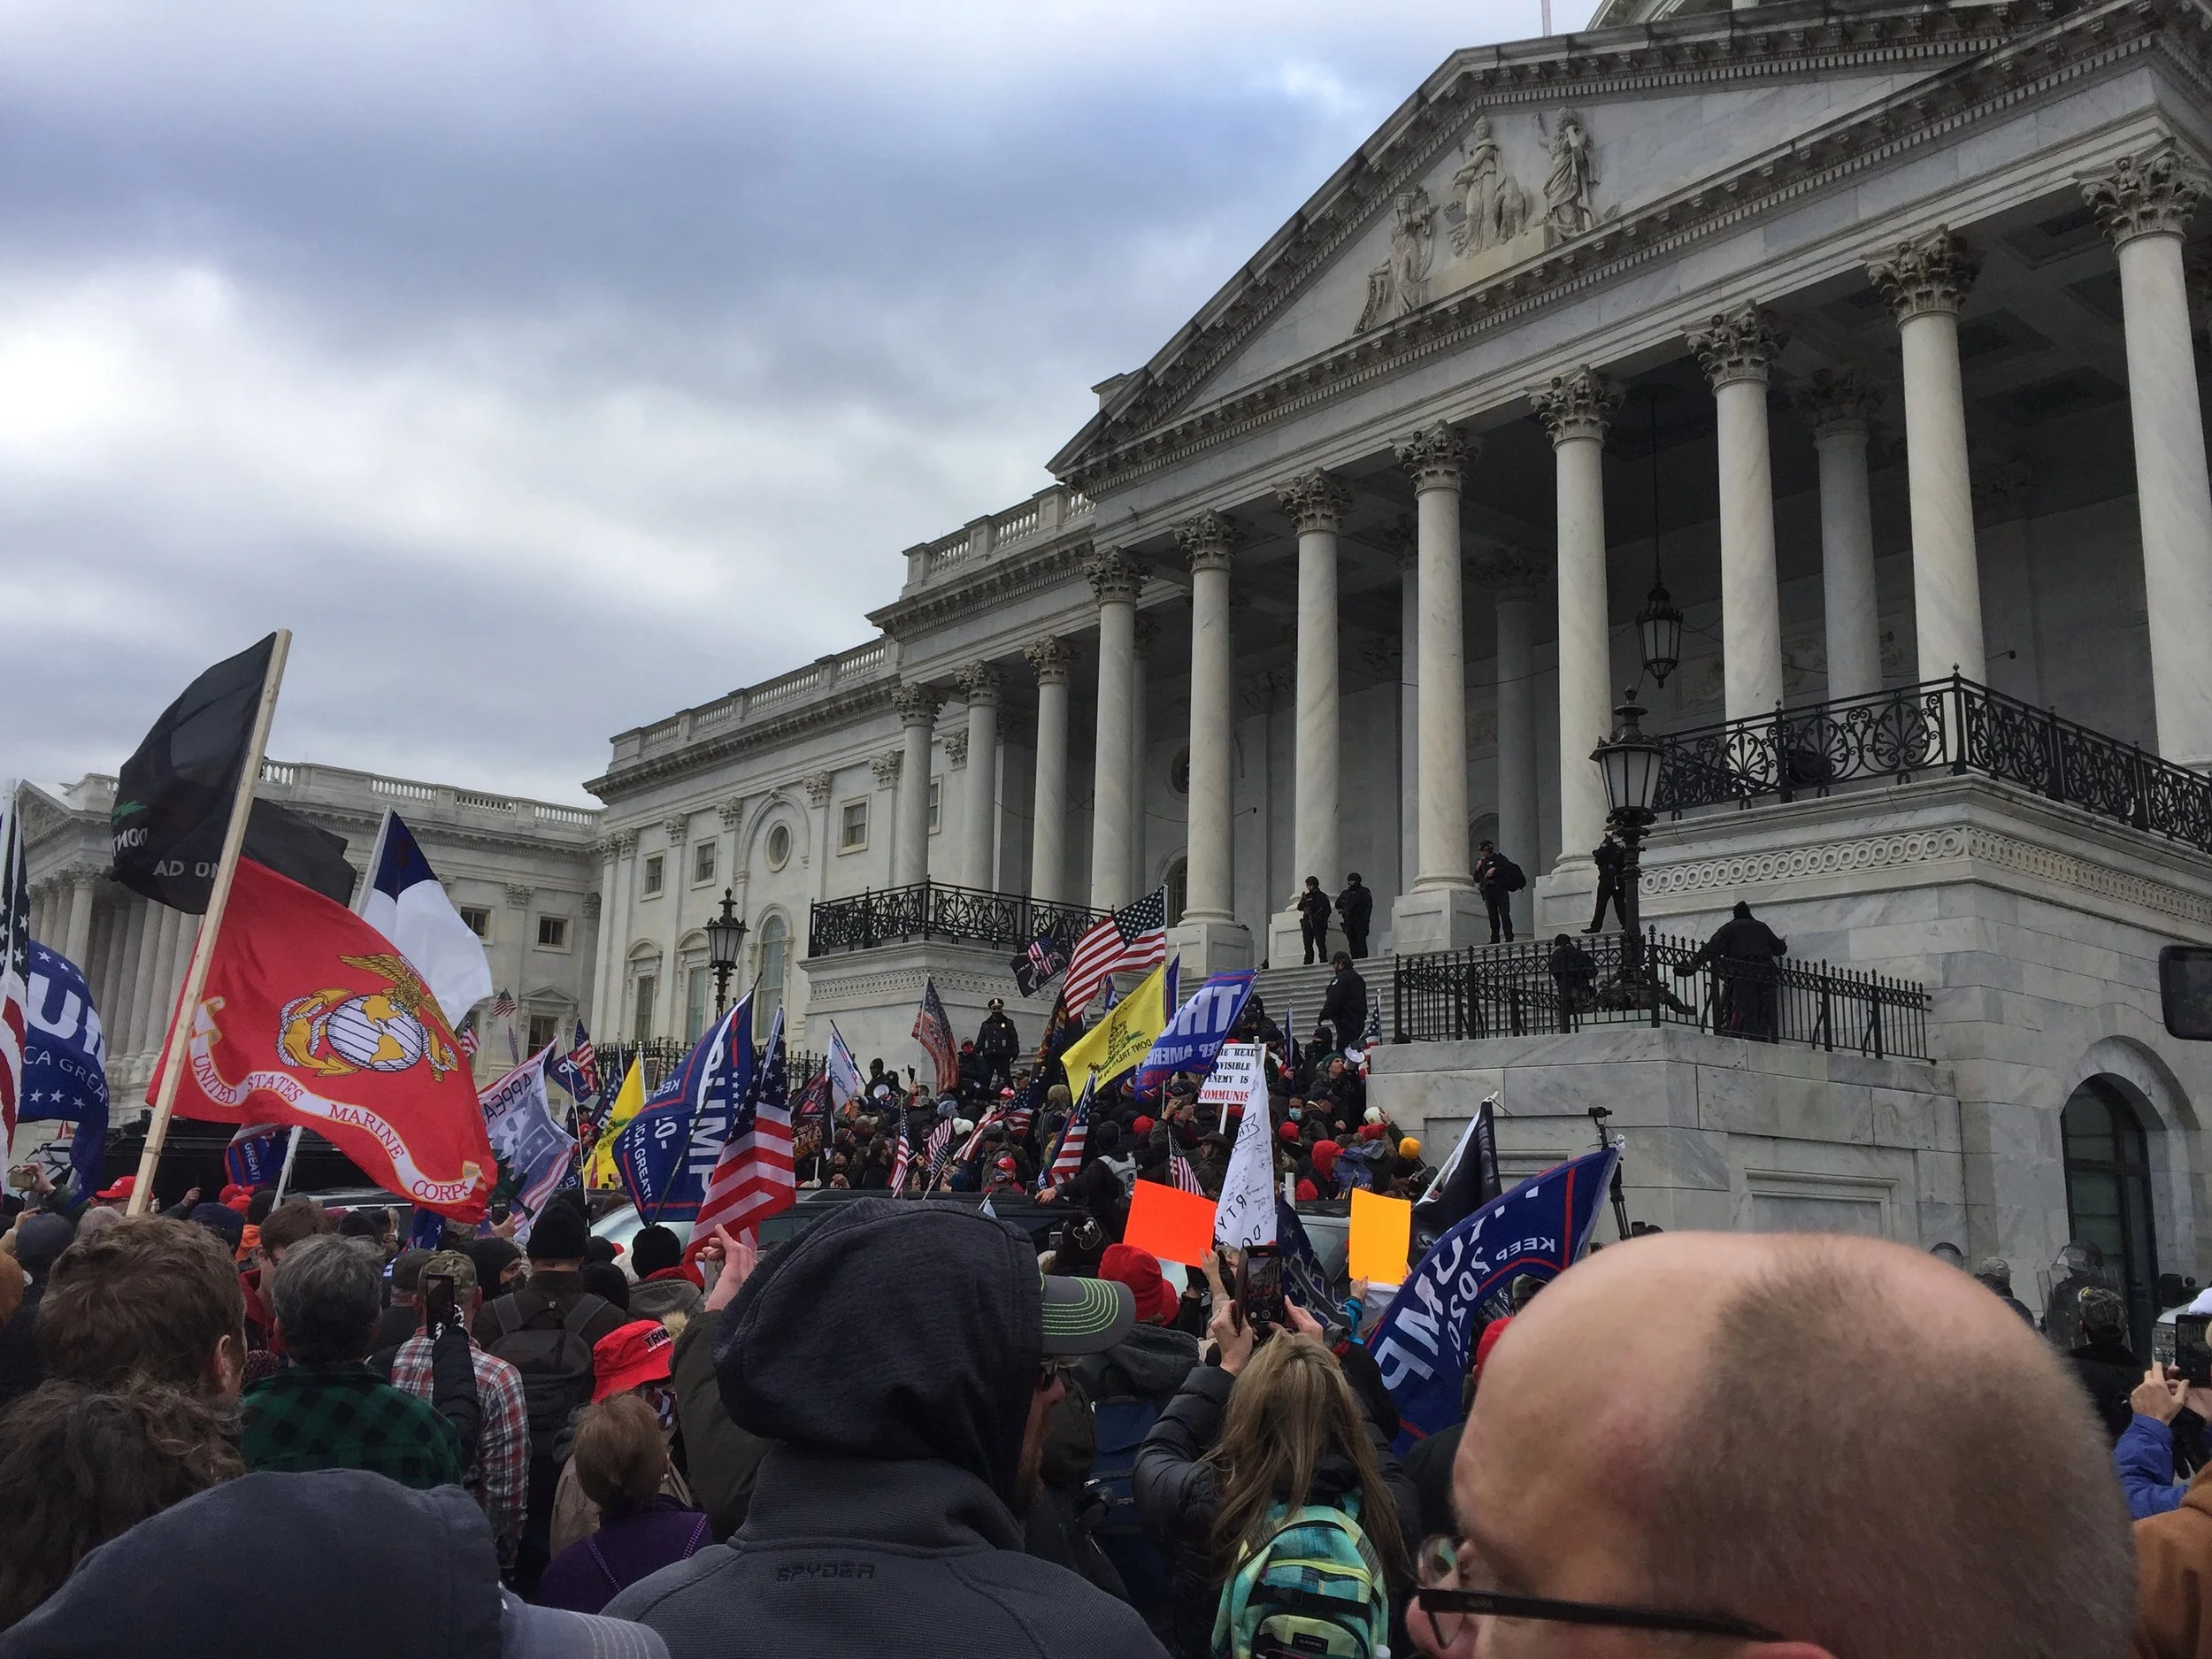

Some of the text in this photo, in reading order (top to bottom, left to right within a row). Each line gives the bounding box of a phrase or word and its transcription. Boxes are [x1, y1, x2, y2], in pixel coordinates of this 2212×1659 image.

[59, 1058, 108, 1107] GREA
[1198, 1089, 1250, 1102] COMMUNIS
[1208, 1074, 1249, 1084] ENEMY IS
[193, 1053, 237, 1104] UNITED
[248, 1073, 304, 1102] STATES
[327, 1104, 404, 1160] MARINE
[634, 1148, 652, 1202] GREAT!
[775, 1560, 876, 1583] SPYDER
